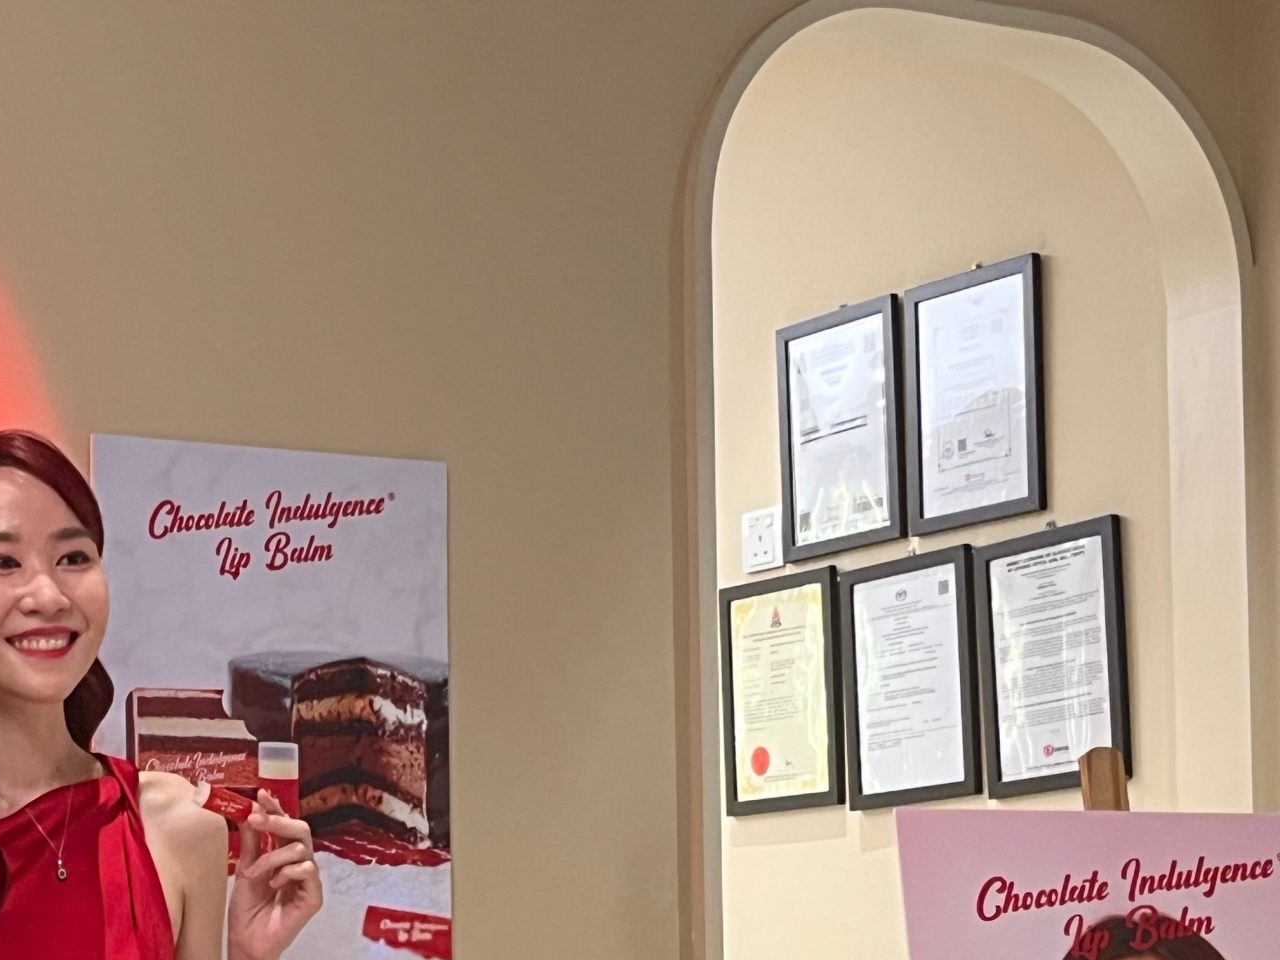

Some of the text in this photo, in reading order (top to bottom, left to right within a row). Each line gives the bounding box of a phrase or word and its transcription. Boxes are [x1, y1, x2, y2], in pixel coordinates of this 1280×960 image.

[148, 499, 255, 540] Chocolate
[215, 531, 334, 580] Lip Balm
[976, 870, 1110, 922] Chocolate
[1125, 904, 1216, 950] Balm
